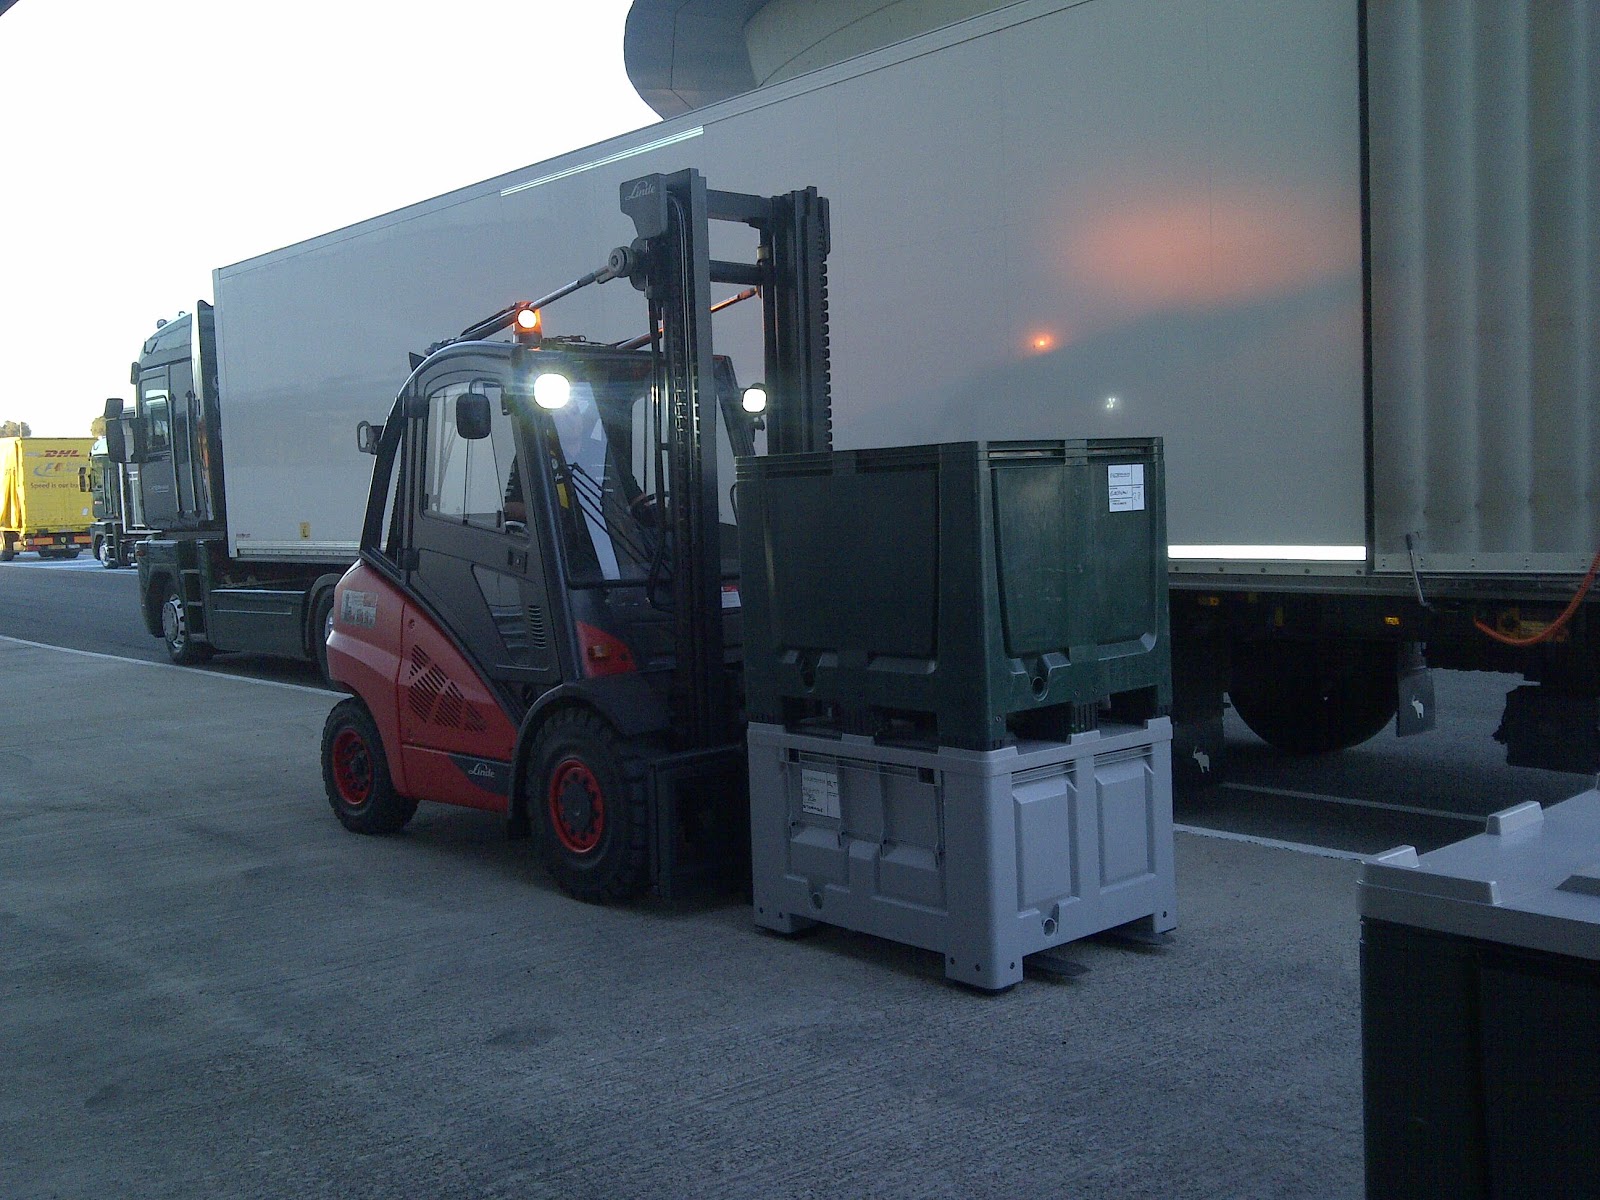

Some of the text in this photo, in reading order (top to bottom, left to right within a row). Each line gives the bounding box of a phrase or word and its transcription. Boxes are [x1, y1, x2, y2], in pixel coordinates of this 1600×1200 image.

[625, 181, 656, 200] Linde
[30, 482, 50, 490] Speed
[468, 762, 495, 778] Linde
